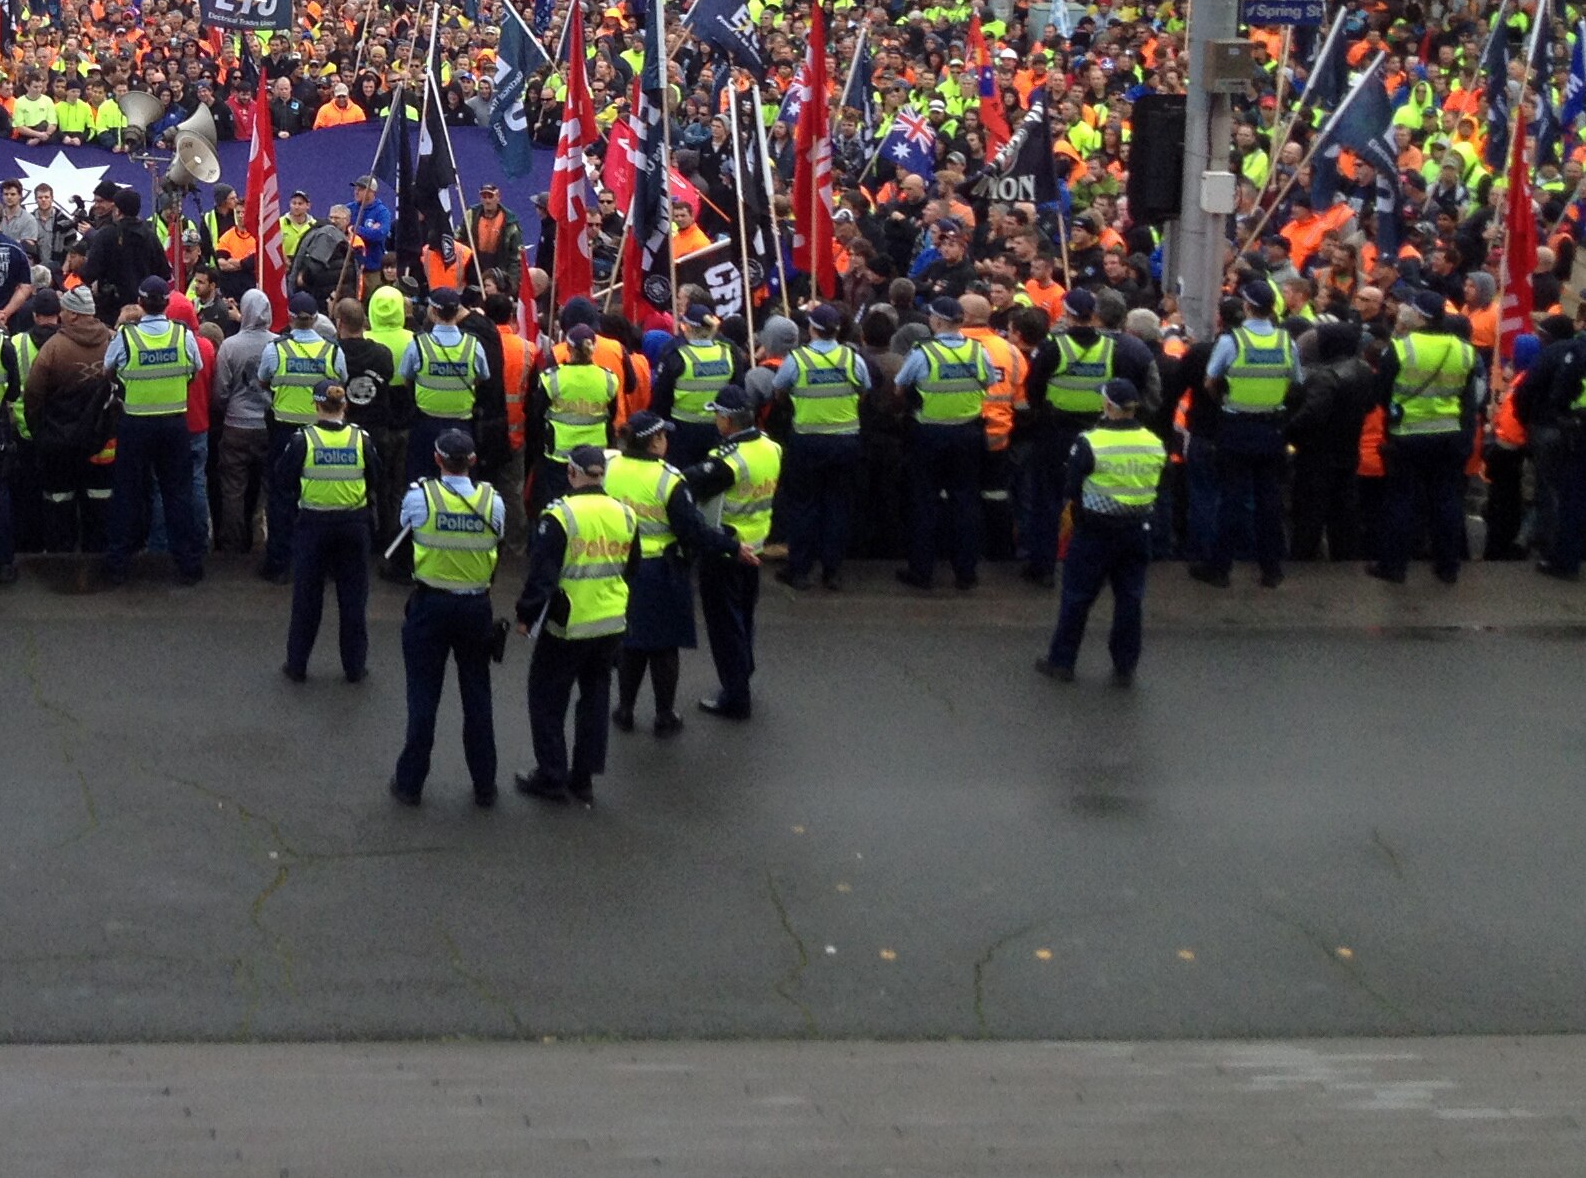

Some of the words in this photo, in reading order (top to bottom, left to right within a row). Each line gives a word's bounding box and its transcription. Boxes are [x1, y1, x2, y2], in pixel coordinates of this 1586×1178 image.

[1256, 4, 1302, 20] Spring
[1306, 4, 1322, 18] St
[140, 349, 177, 364] Police
[315, 448, 356, 464] Police
[437, 514, 484, 531] Police
